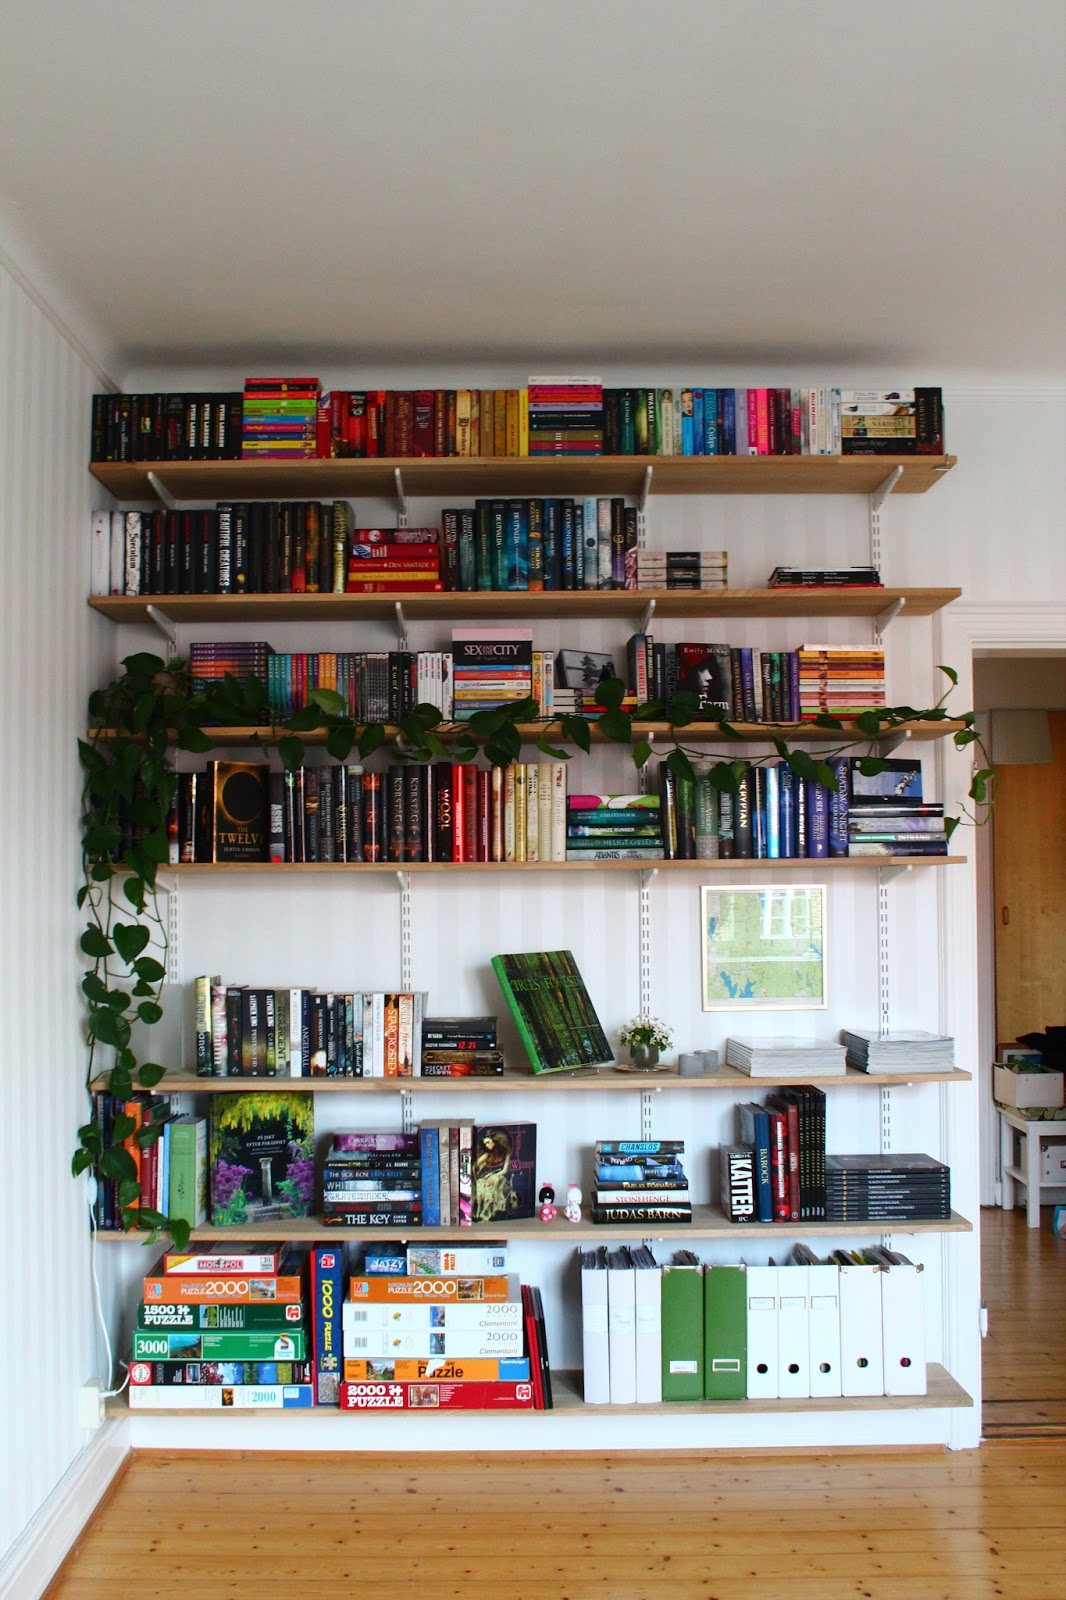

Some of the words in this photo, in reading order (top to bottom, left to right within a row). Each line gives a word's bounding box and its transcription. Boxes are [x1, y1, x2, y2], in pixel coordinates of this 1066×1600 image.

[219, 514, 230, 548] BEAUTIFUL
[219, 550, 230, 586] CREATURES
[464, 645, 483, 655] SEX
[494, 644, 519, 655] CITY
[839, 766, 848, 804] SHADOW
[739, 780, 748, 828] KRYPTAN
[440, 789, 450, 832] WOOL
[271, 804, 282, 833] ASHES
[510, 978, 541, 992] TREES
[545, 975, 582, 989] FORESTS
[214, 1007, 225, 1065] delirium
[278, 1006, 286, 1060] INSURGENT
[385, 1010, 397, 1070] STARCROSSED
[760, 1148, 768, 1184] BAROCK
[327, 1182, 355, 1190] WHITE
[731, 1159, 753, 1215] KATTER
[345, 1214, 367, 1224] THE
[606, 1210, 644, 1220] JUDAS
[647, 1210, 681, 1219] BARN
[372, 1258, 404, 1268] YATZY
[147, 1284, 162, 1295] MB
[206, 1282, 248, 1294] 2000
[354, 1282, 368, 1293] MB
[413, 1281, 456, 1294] 2000
[321, 1280, 333, 1318] 1000
[144, 1306, 174, 1314] 1500
[487, 1305, 517, 1314] 2000
[144, 1315, 193, 1325] PUZZLE
[487, 1333, 517, 1341] 2000
[137, 1340, 167, 1353] 3000
[347, 1385, 386, 1395] 2000
[252, 1392, 276, 1402] 2000
[347, 1397, 403, 1407] PUZZLE
